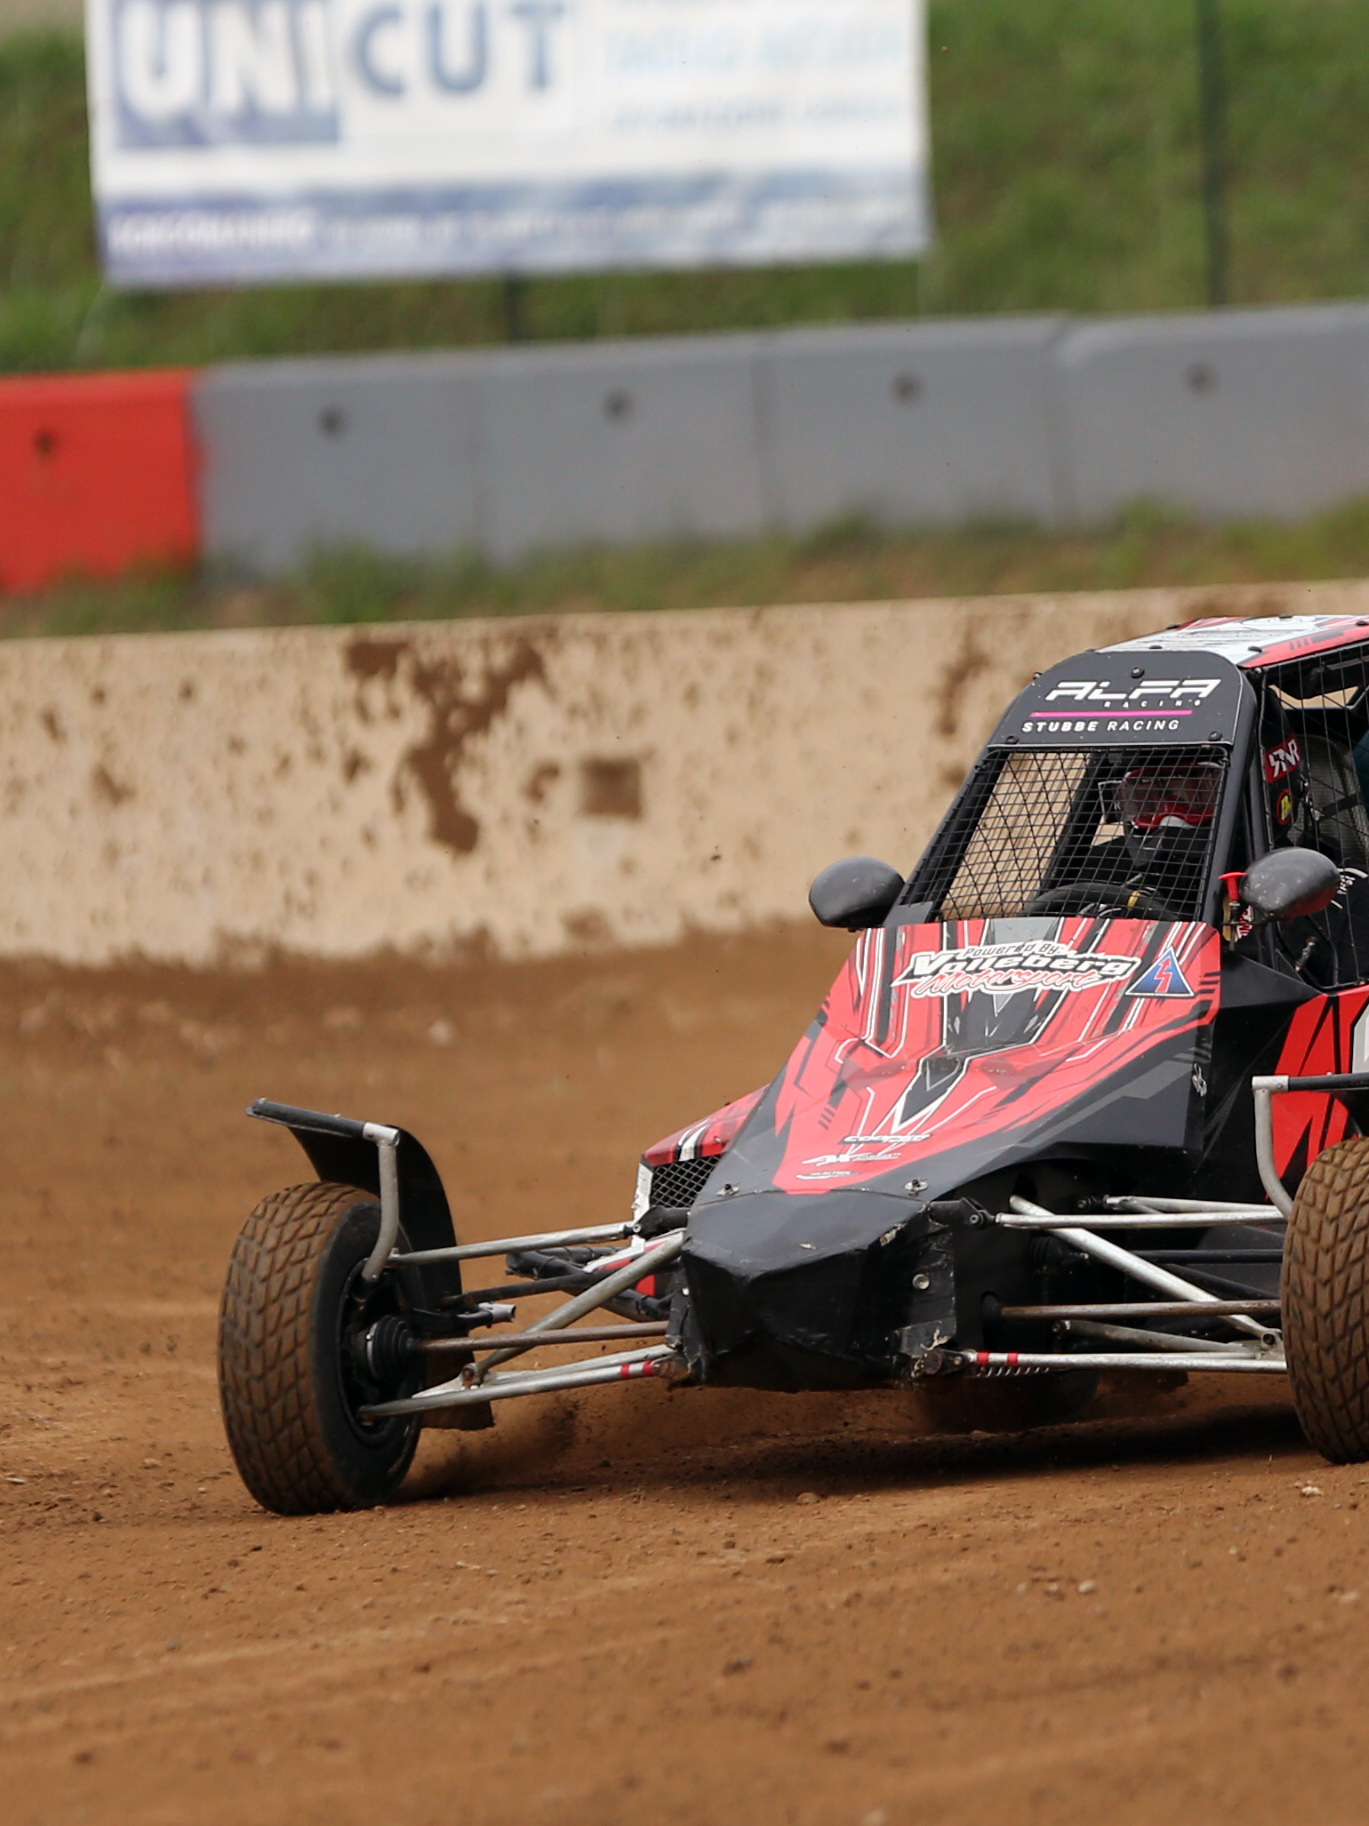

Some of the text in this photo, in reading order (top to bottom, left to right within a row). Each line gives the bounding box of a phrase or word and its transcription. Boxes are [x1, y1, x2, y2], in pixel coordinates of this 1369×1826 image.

[1045, 679, 1222, 701] ALFA
[1021, 719, 1181, 733] STUBBE RACING
[964, 943, 1034, 958] Powered
[915, 968, 1102, 994] Motorsport
